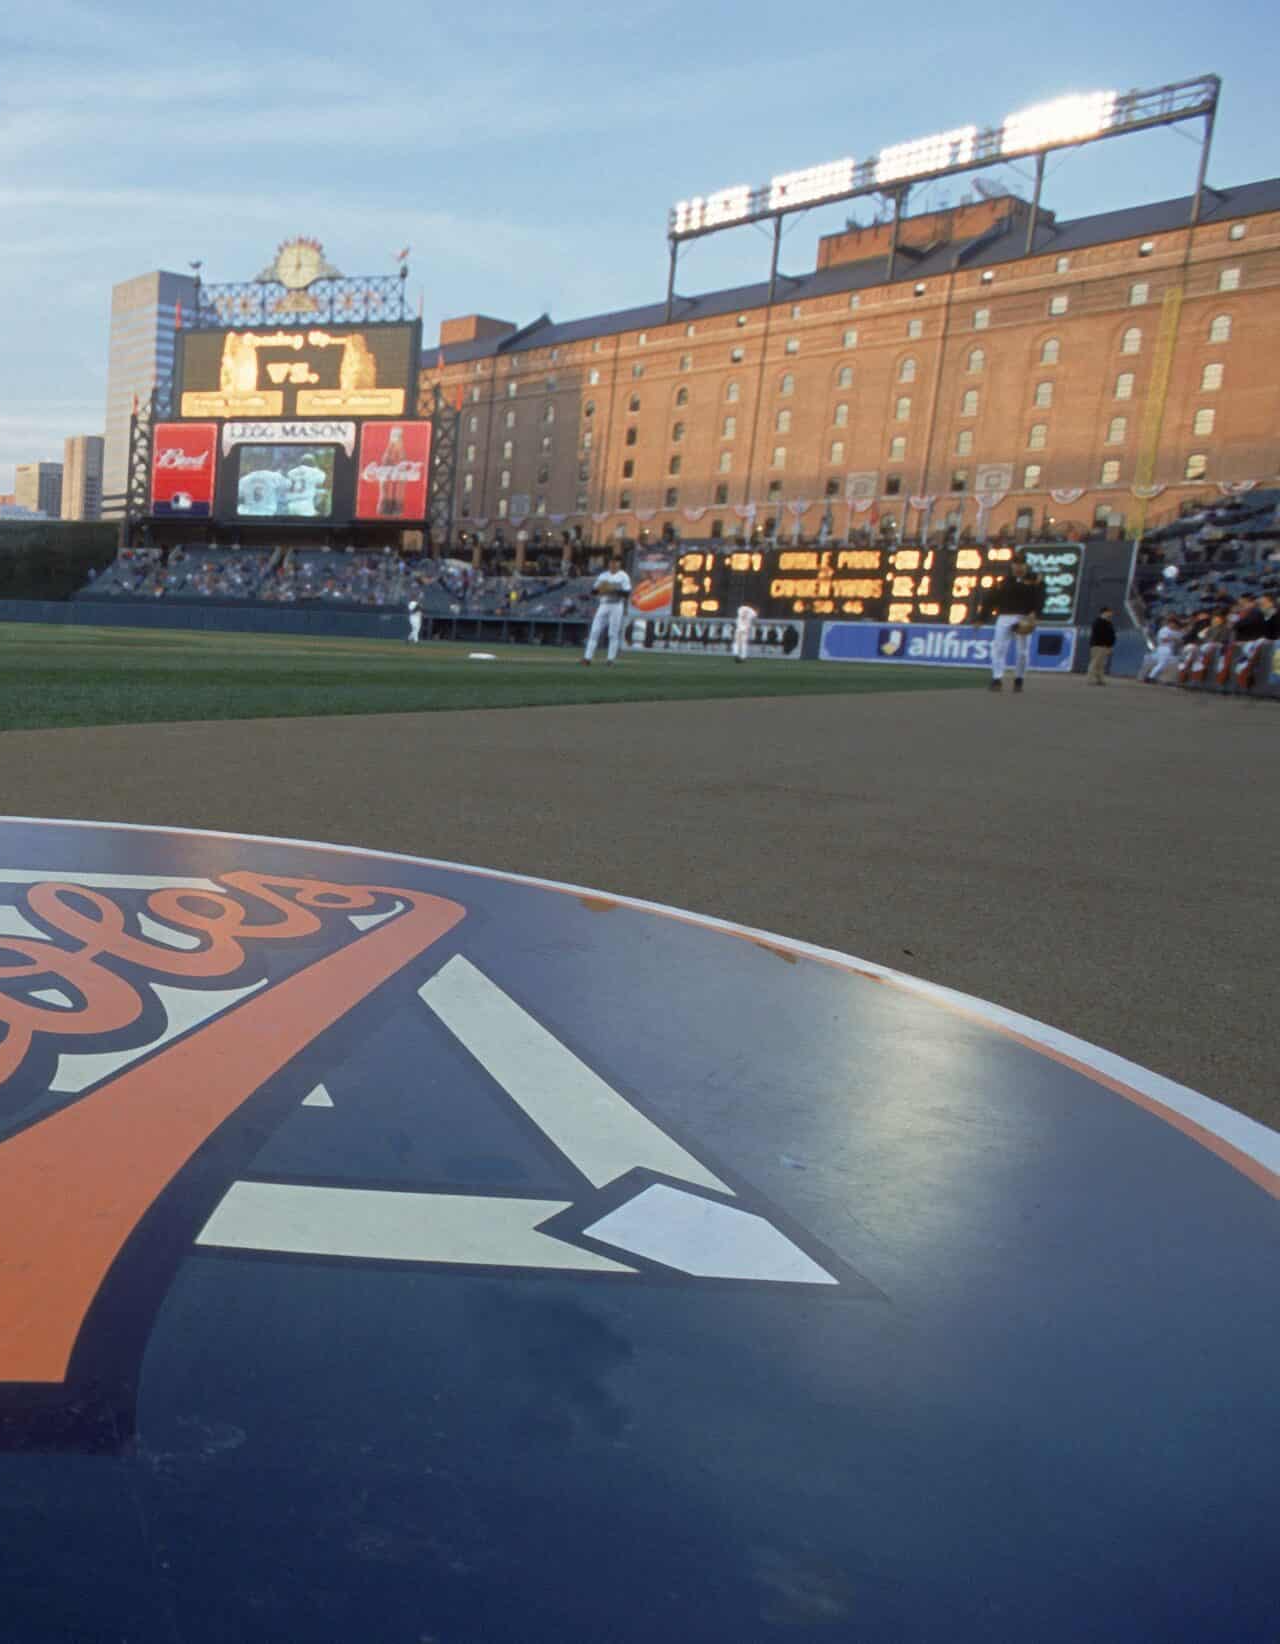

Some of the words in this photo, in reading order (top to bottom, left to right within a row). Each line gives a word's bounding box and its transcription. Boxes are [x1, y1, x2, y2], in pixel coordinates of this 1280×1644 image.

[281, 423, 348, 438] MASON
[653, 620, 787, 643] UNIVERITY
[908, 630, 993, 660] allfirs
